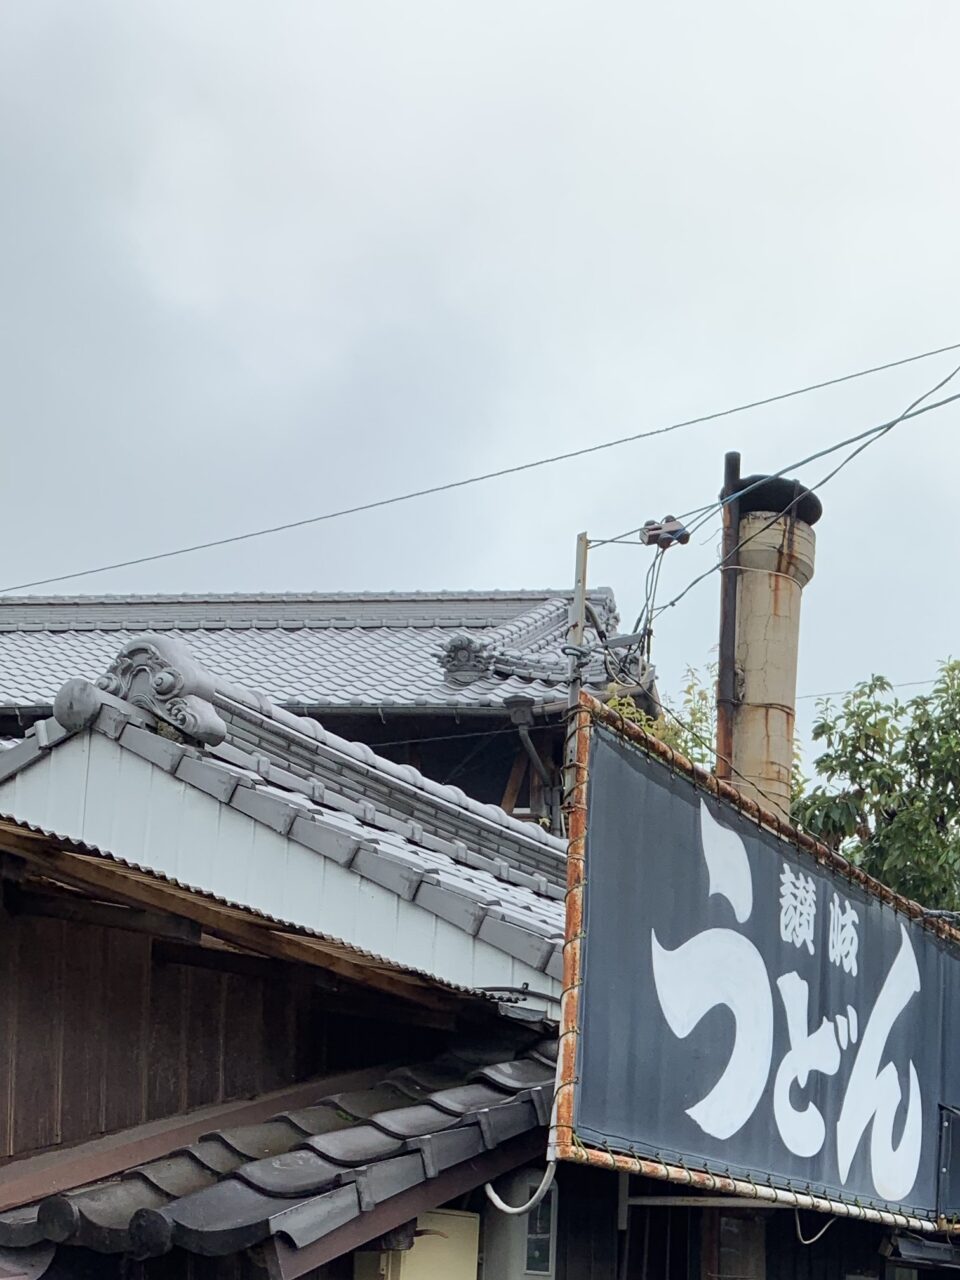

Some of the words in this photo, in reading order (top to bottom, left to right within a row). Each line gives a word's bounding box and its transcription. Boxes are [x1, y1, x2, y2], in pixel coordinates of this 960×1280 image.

[652, 798, 923, 1202] うどん
[779, 863, 859, 977] 讃岐
